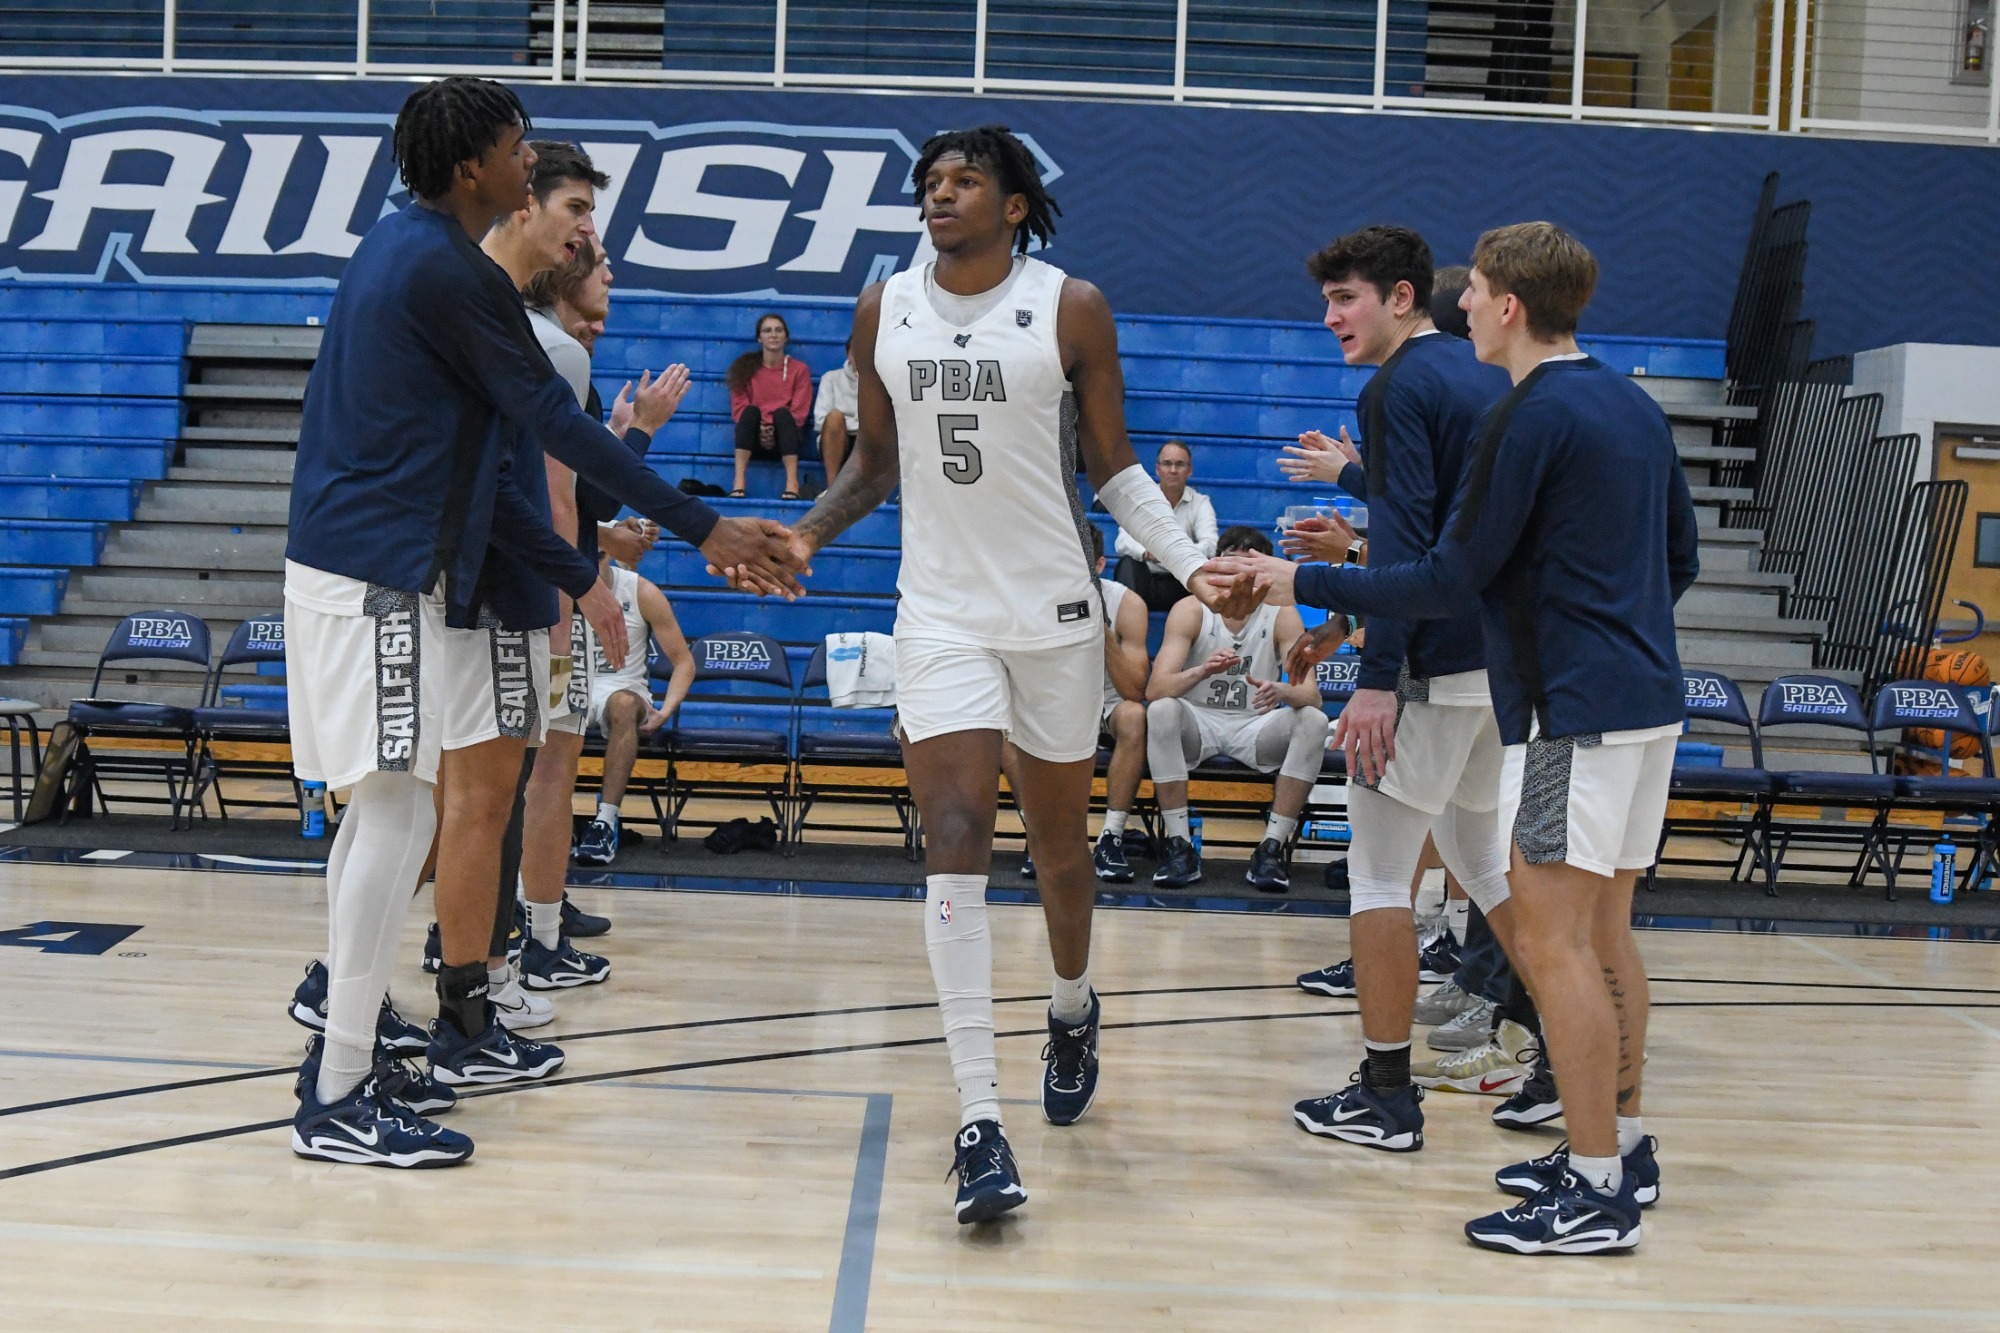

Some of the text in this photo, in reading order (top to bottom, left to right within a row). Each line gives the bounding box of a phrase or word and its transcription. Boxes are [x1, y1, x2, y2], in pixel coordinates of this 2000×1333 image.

[907, 359, 1007, 402] PBA
[937, 413, 983, 485] 5
[130, 618, 192, 640] PBA
[248, 621, 285, 641] PB
[127, 638, 192, 648] SAILFISH
[703, 640, 771, 661] PBA
[704, 661, 771, 670] SAILFISH
[380, 610, 415, 761] SAILFISH
[1207, 680, 1247, 709] 33
[1683, 677, 1728, 698] BA
[1779, 683, 1847, 705] PBA
[1890, 688, 1960, 708] PBA
[1783, 704, 1848, 714] SAILFISH
[1895, 708, 1959, 718] SAILFISH
[1942, 854, 1952, 895] POWERADE
